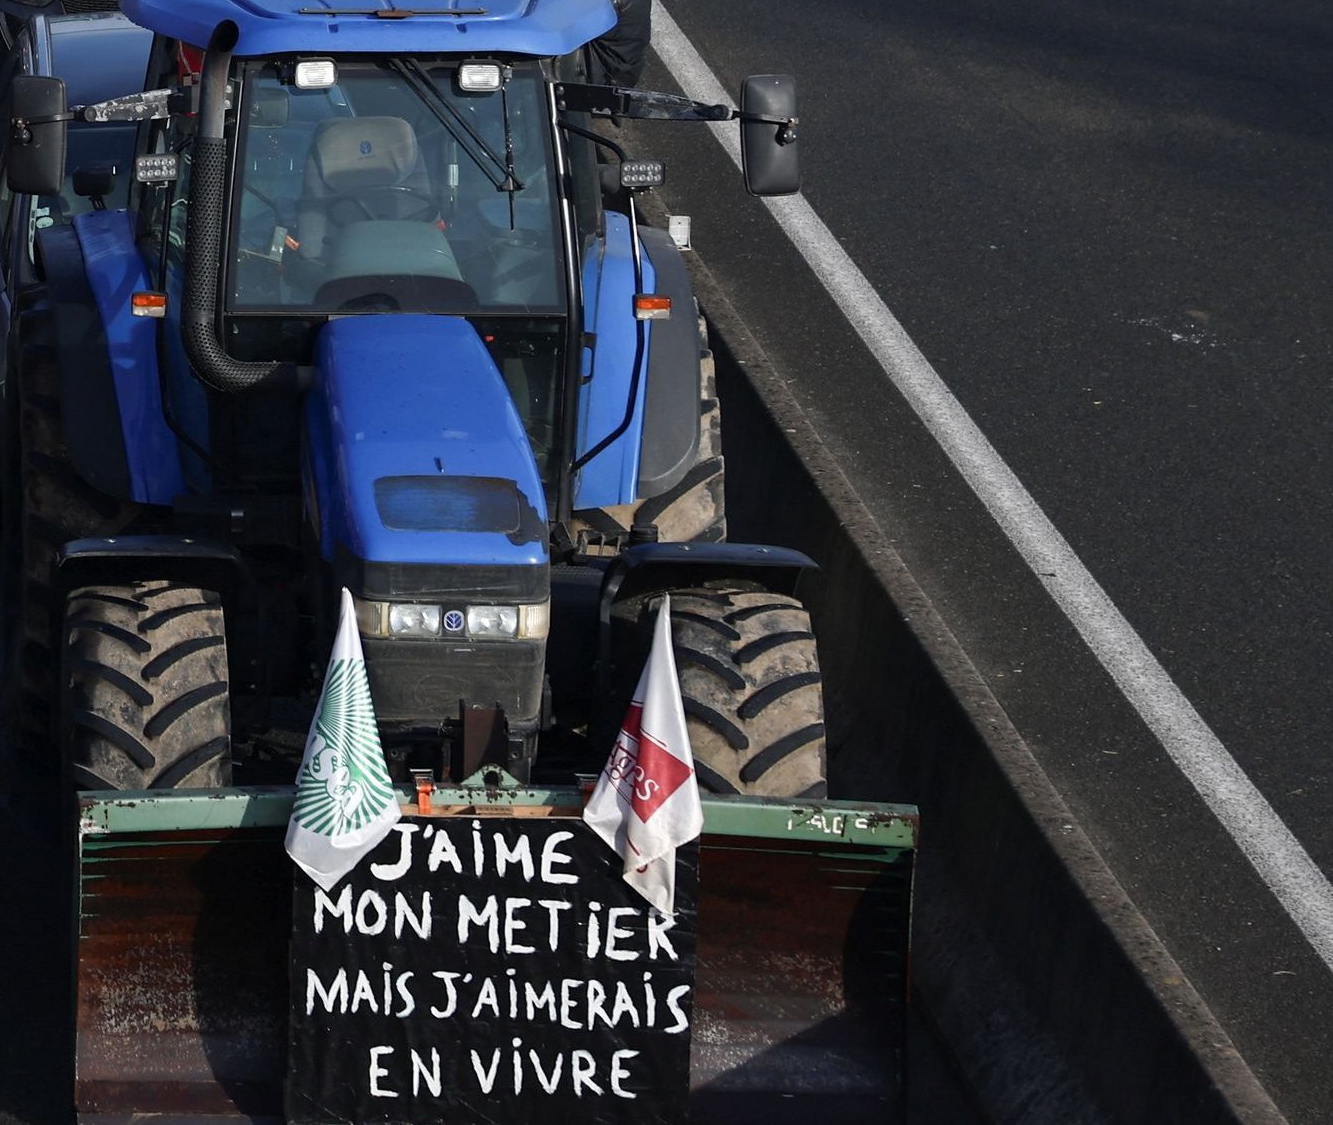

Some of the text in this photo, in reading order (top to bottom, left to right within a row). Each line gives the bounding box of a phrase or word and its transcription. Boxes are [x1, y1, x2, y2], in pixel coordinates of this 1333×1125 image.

[313, 887, 432, 940] MON
[305, 962, 416, 1018] MAIS
[369, 1037, 640, 1099] EN VIVRE
